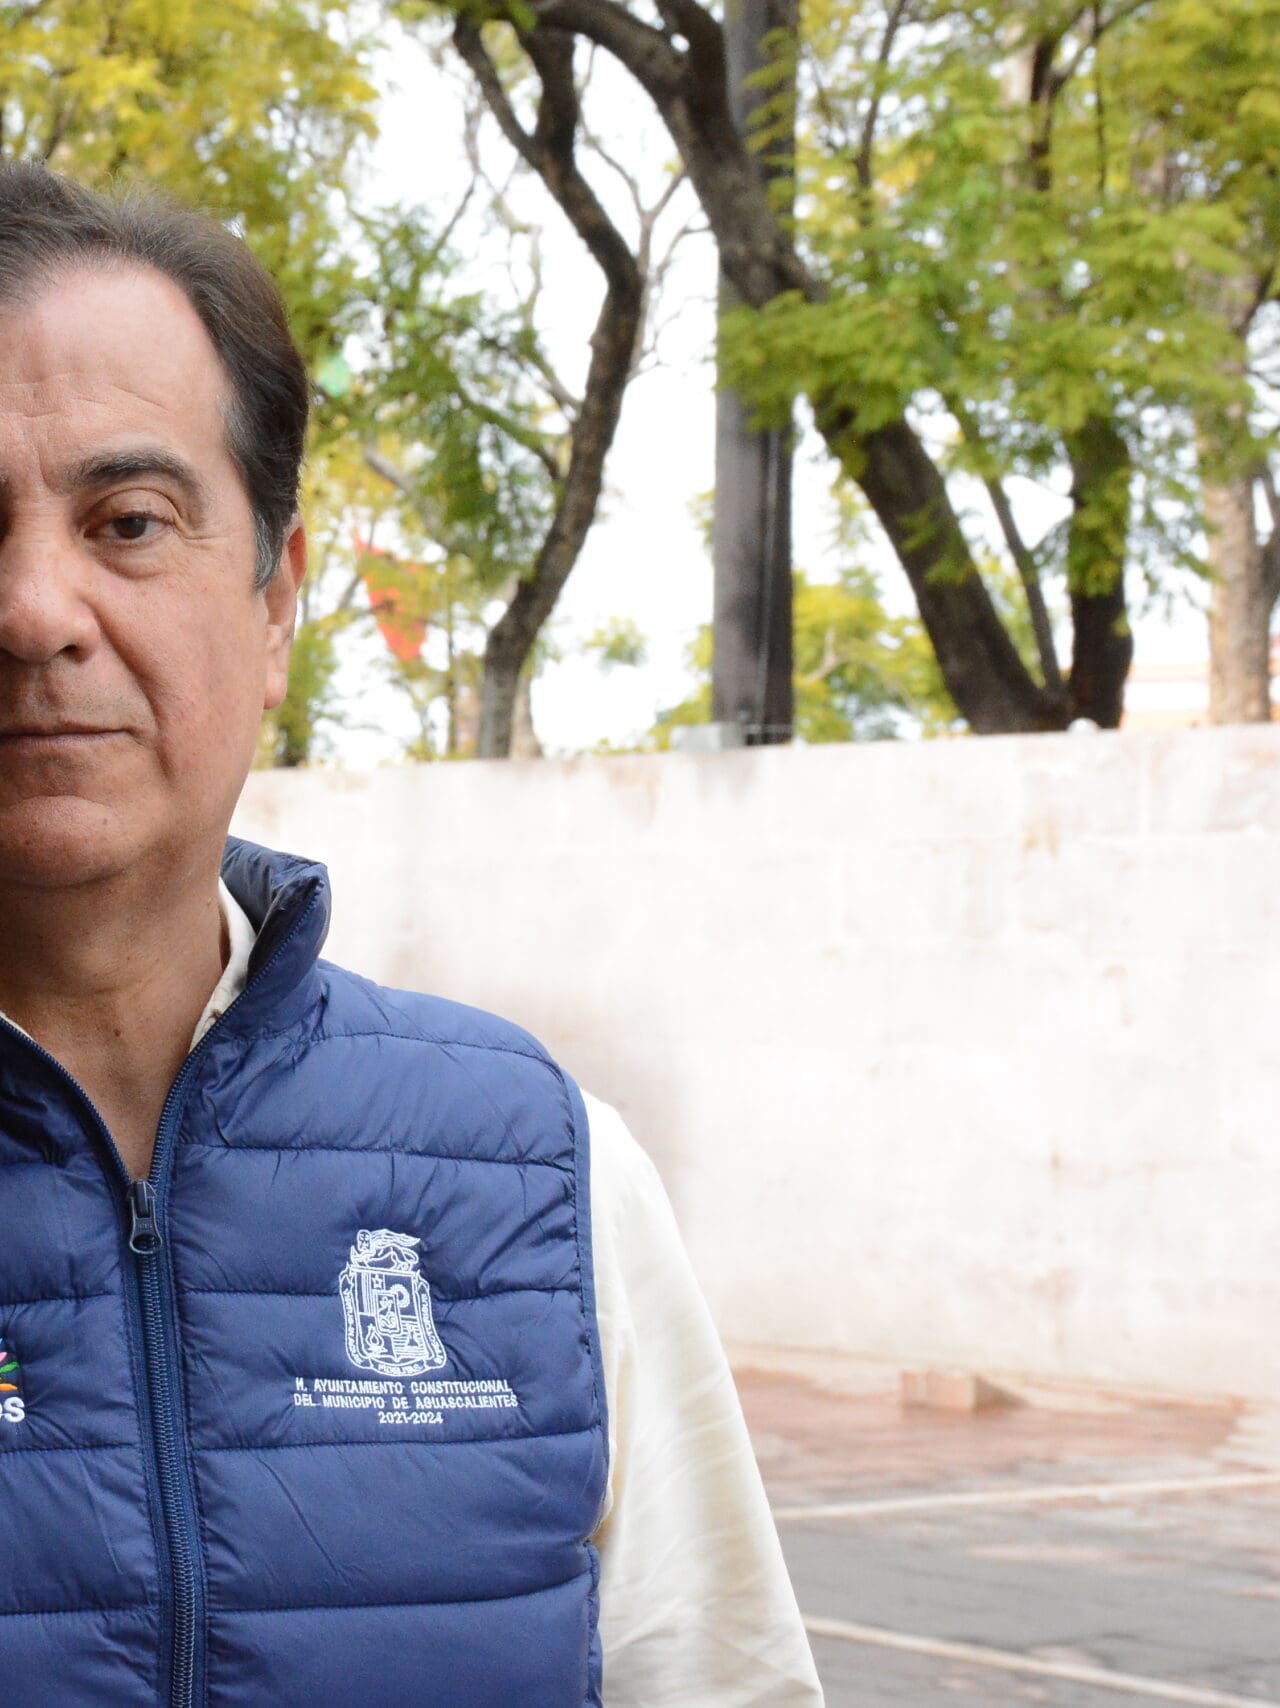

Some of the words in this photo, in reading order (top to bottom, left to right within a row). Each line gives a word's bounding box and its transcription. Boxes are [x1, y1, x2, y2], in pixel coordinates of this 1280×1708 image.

[313, 1379, 404, 1394] AYUNTAMIENTO
[410, 1379, 513, 1394] CONSTITUCIONAL
[293, 1393, 316, 1407] DEL
[322, 1394, 385, 1409] MUNICIPIO
[391, 1396, 410, 1410] DE
[415, 1394, 519, 1410] AGUASCALIENTES
[378, 1410, 444, 1425] 2021-2024
